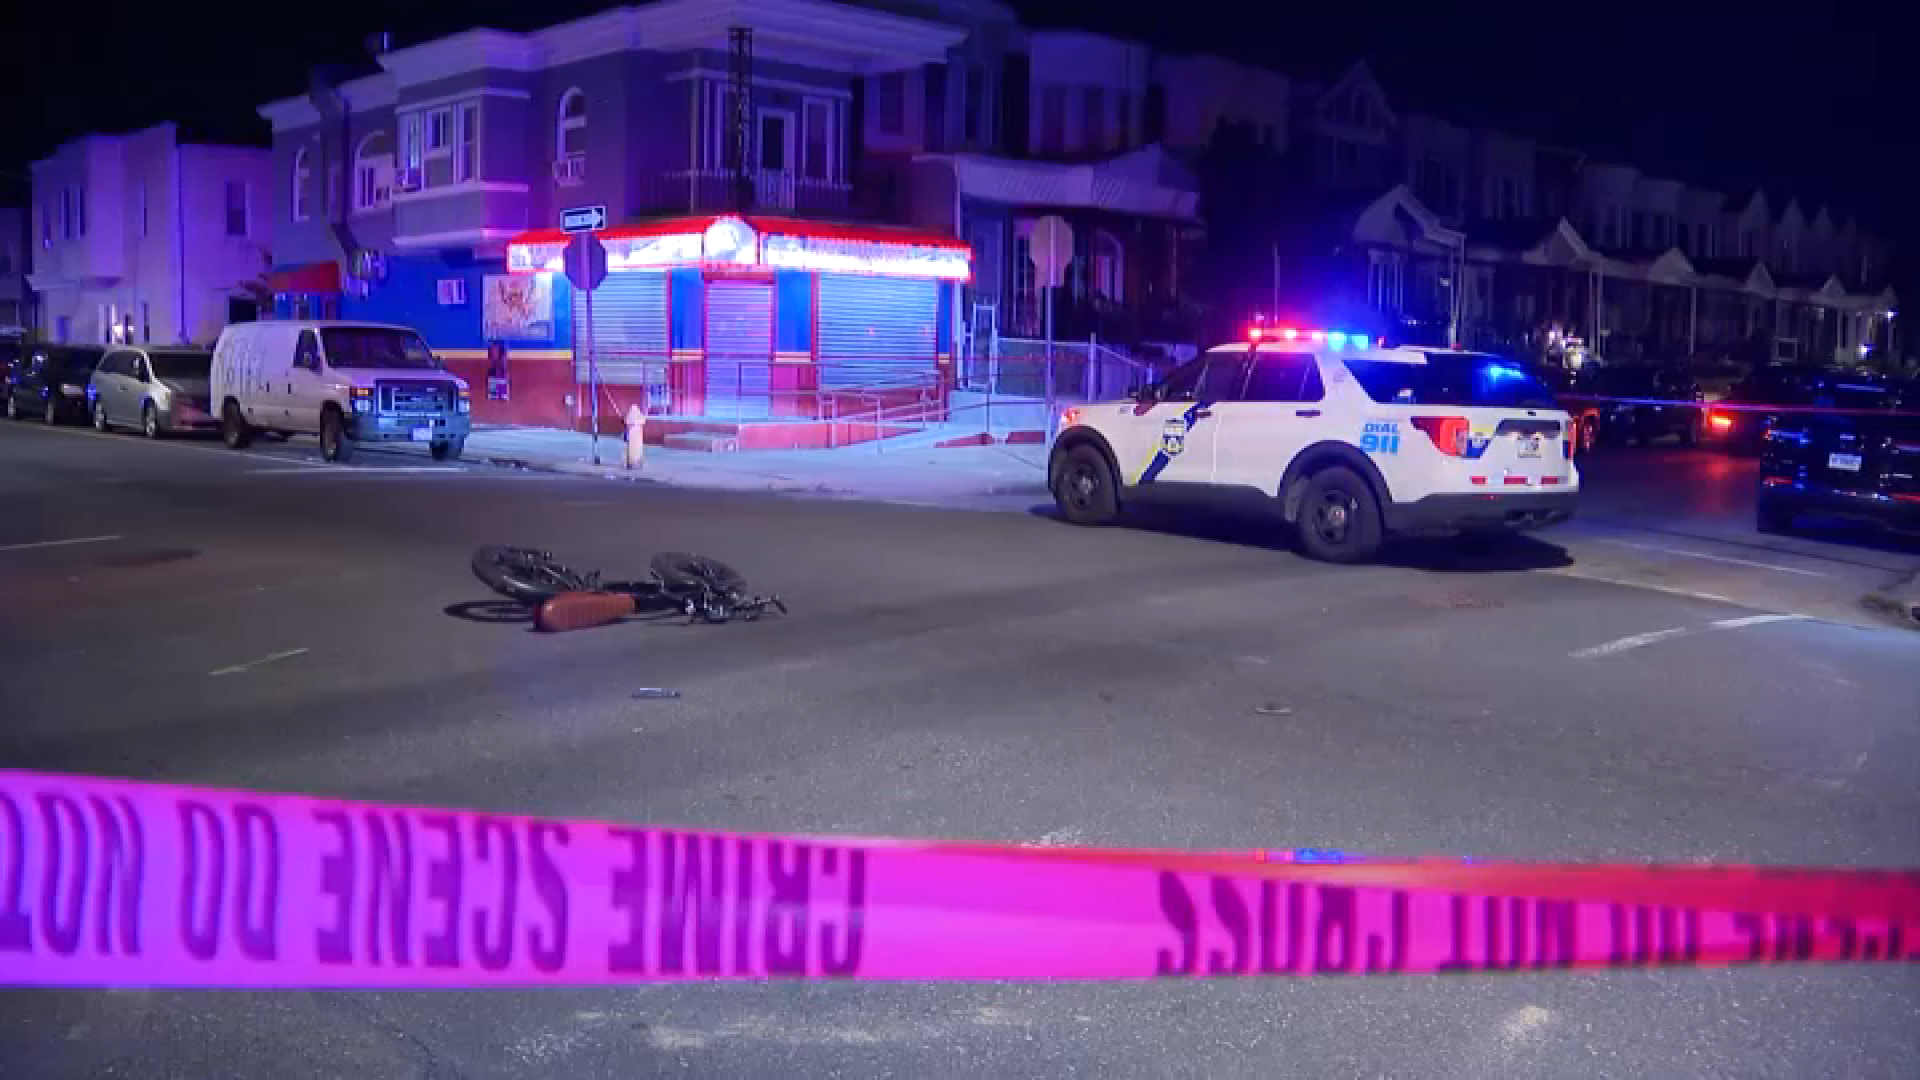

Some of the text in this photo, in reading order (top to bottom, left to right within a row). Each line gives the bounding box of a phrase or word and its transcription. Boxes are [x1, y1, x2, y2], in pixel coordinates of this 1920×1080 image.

[1360, 433, 1398, 454] 911
[175, 799, 281, 962] DO
[312, 809, 569, 974] SCENE
[608, 827, 865, 976] CRIME
[1156, 867, 1410, 977] CROSS
